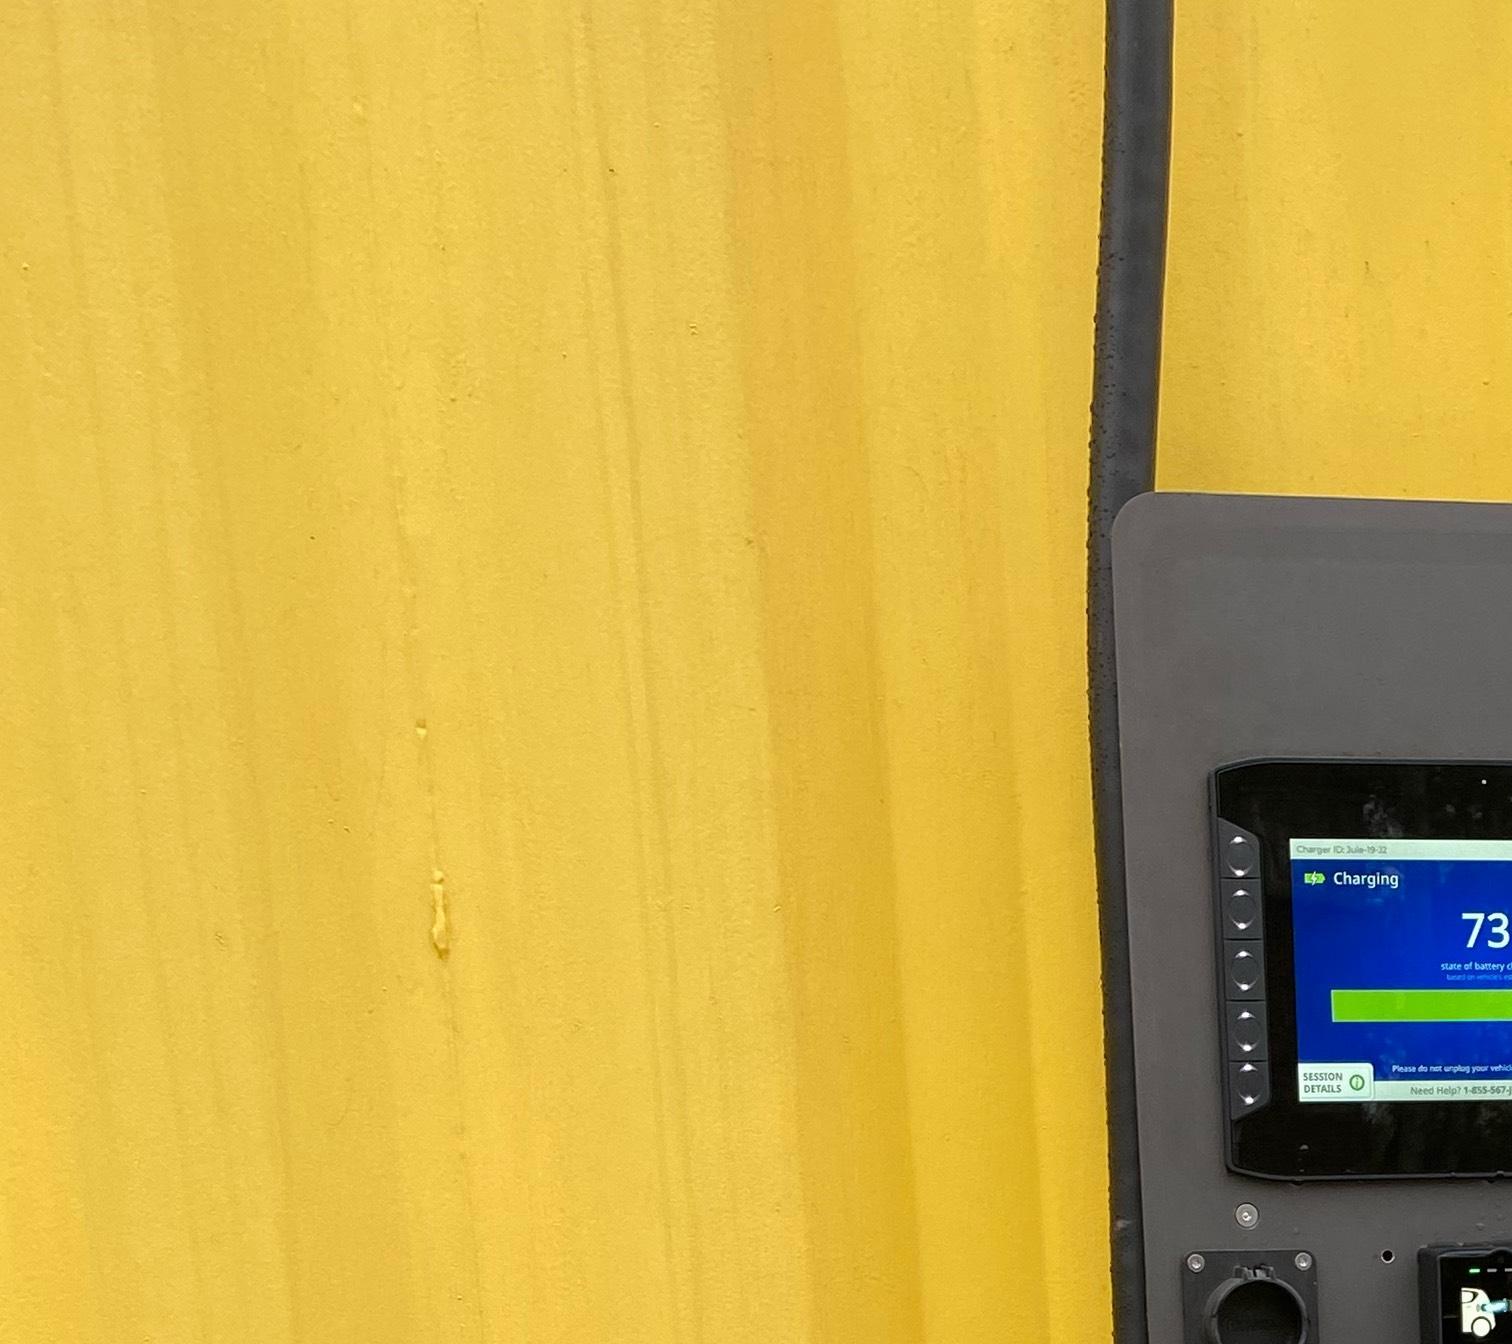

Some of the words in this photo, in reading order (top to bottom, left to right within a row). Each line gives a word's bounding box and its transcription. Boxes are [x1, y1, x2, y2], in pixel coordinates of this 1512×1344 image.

[1296, 845, 1331, 856] Charger
[1333, 871, 1399, 889] Charging
[1461, 912, 1510, 948] 73
[1440, 962, 1462, 971] state
[1463, 961, 1473, 971] of
[1474, 961, 1505, 973] battery
[1391, 1064, 1417, 1074] Please
[1417, 1064, 1428, 1073] do
[1429, 1064, 1442, 1073] not
[1443, 1064, 1471, 1075] unplug
[1471, 1065, 1489, 1075] your
[1302, 1072, 1343, 1082] SESSION
[1303, 1084, 1342, 1094] DETAILS
[1409, 1086, 1435, 1095] Need
[1436, 1085, 1462, 1096] Help?
